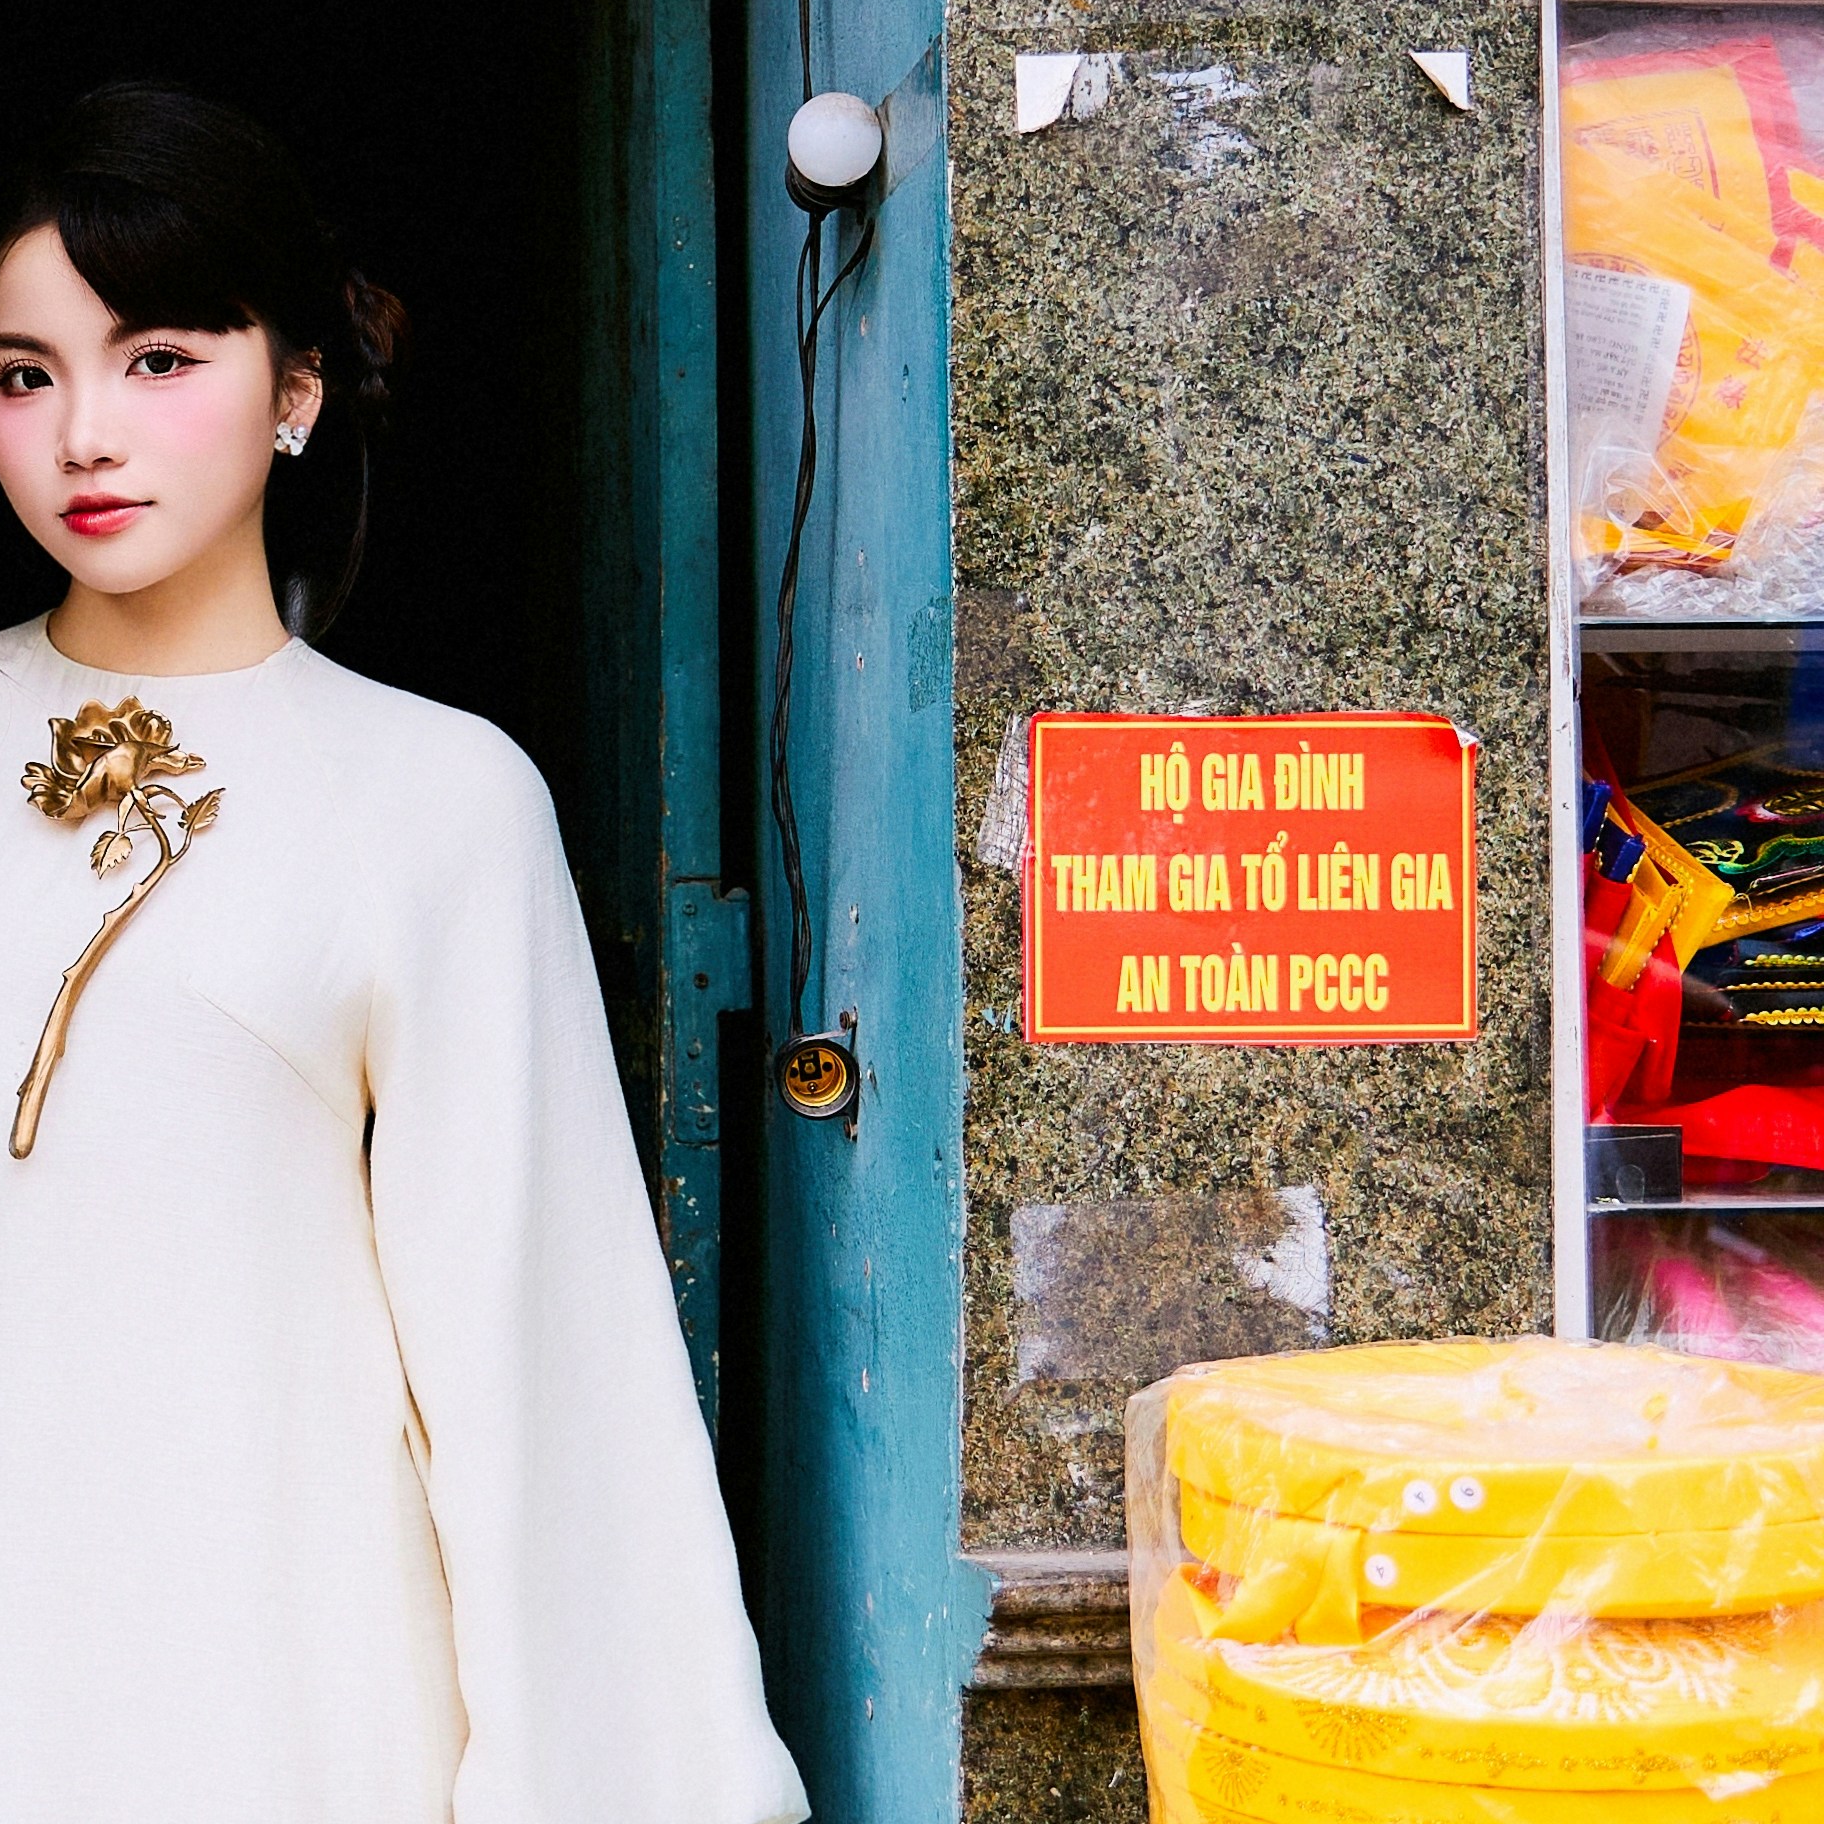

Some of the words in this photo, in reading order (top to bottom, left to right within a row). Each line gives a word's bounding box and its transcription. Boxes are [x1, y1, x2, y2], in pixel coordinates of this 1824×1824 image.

[1140, 742, 1189, 823] HỘ
[1201, 753, 1264, 811] GIA
[1273, 741, 1365, 811] ĐÌNH
[1051, 854, 1157, 912] THAM
[1168, 853, 1232, 912] GIA
[1241, 831, 1289, 912] TỔ
[1298, 841, 1380, 912] LIÊN
[1390, 853, 1454, 911] GIA
[1116, 955, 1171, 1013] AN
[1179, 943, 1278, 1013] TOÀN
[1289, 953, 1390, 1014] PCCC
